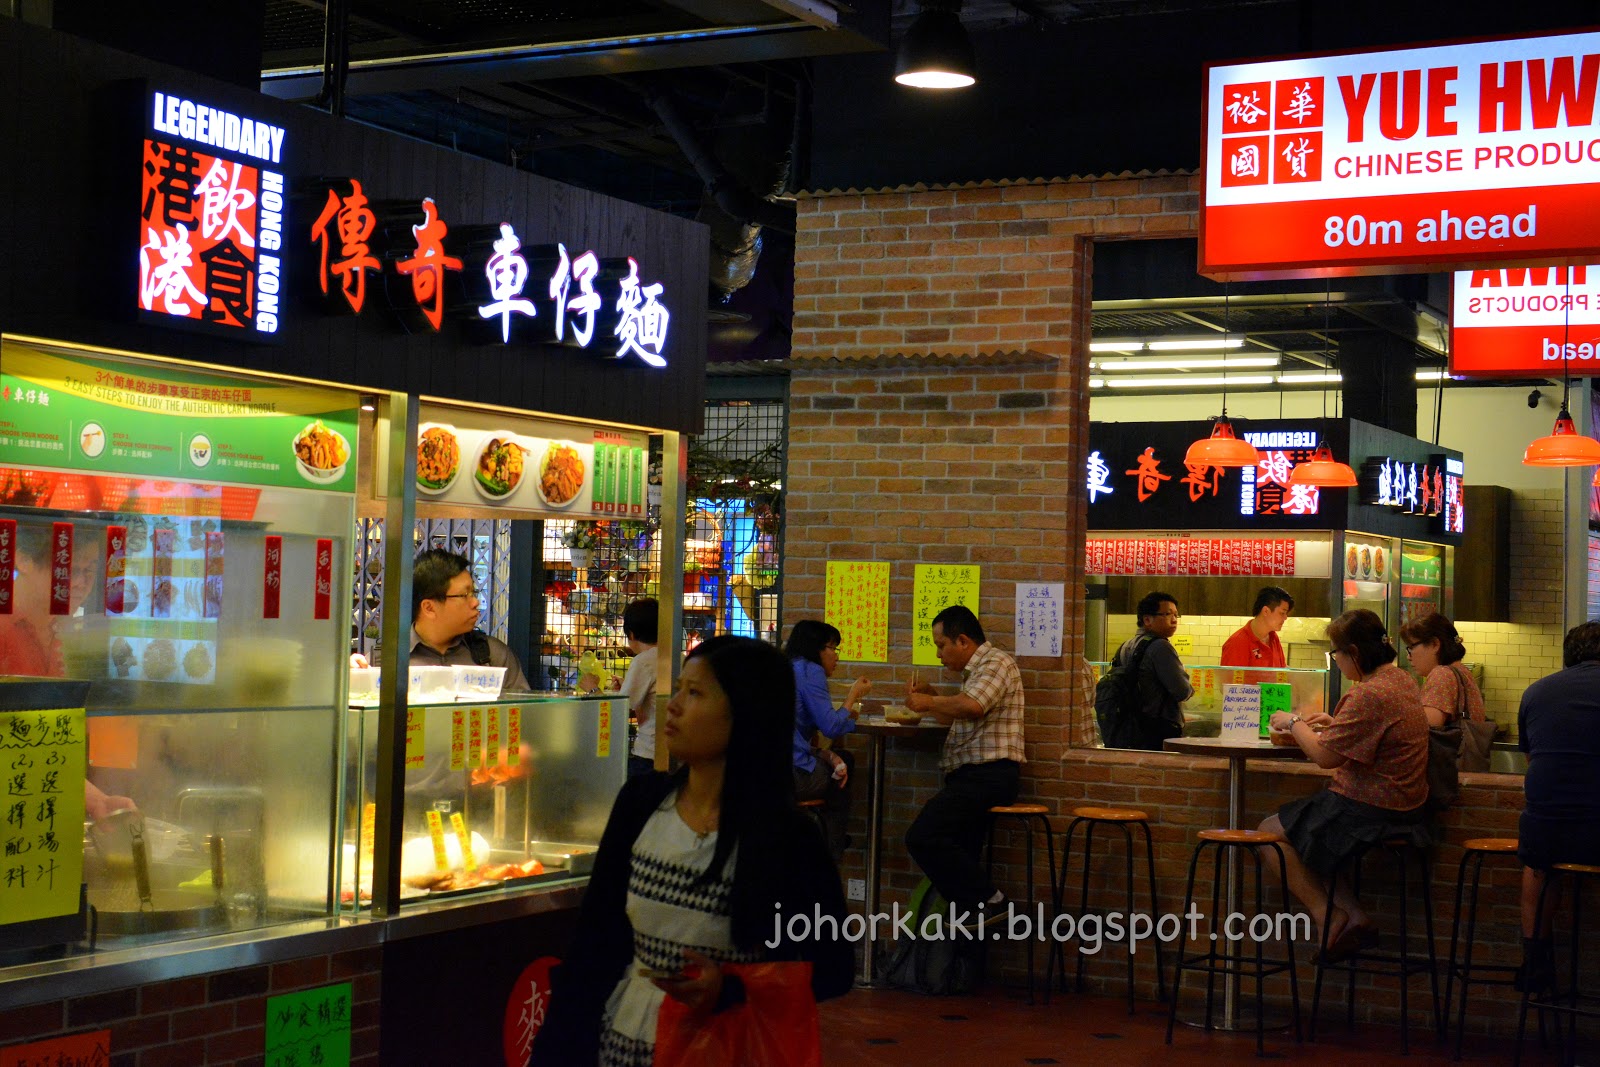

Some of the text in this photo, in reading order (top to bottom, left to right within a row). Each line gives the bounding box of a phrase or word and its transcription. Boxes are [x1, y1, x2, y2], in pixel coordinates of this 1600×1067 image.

[1226, 82, 1317, 125] 裕華
[1337, 53, 1600, 143] YUE HW
[154, 92, 285, 164] LEGENDARY
[1230, 137, 1315, 179] 國貨
[1334, 149, 1462, 178] CHINESE
[1323, 204, 1537, 248] 80m ahead
[256, 170, 284, 333] HONG KONG
[310, 178, 671, 368] 傳奇車仔麵
[64, 376, 277, 415] 3 EASY STEPS TO ENJOY THE AUTHENTIC CART NOODLE
[38, 433, 59, 441] NOODLE
[0, 714, 74, 747] 麵步驟
